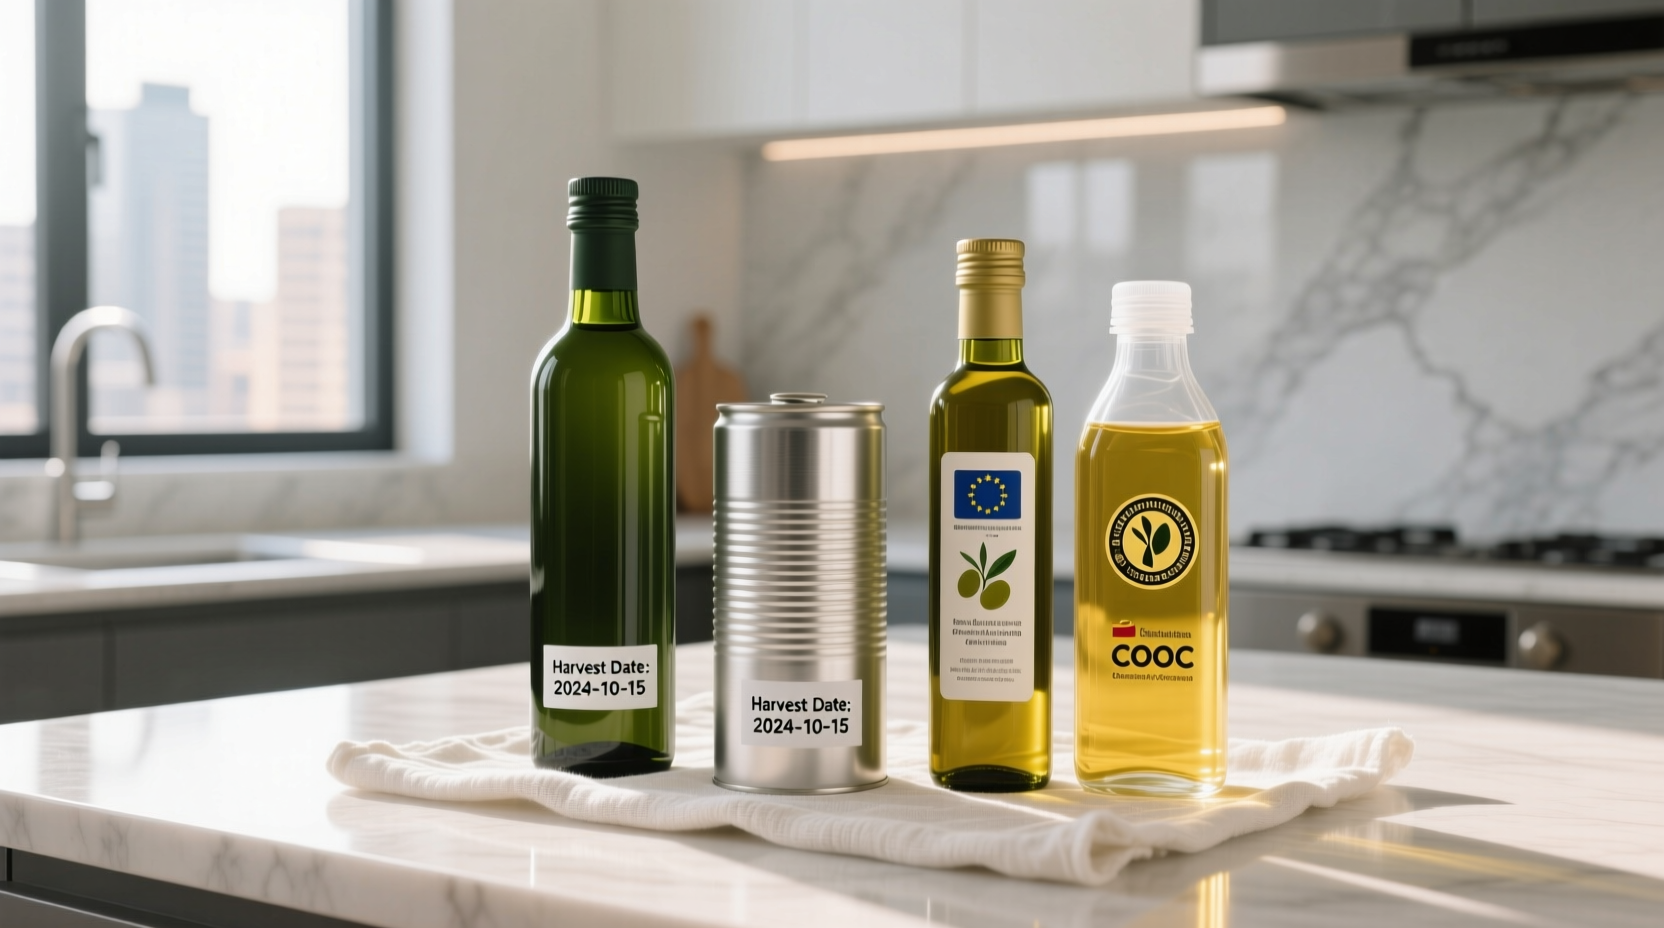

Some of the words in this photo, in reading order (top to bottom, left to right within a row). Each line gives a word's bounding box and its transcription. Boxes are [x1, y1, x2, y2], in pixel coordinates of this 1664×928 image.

[1111, 644, 1194, 669] COOC
[553, 660, 606, 674] Harvest
[611, 660, 650, 674] Date:
[554, 680, 646, 696] 2024-10-15
[752, 696, 808, 712] Harvest
[813, 697, 851, 712] Date:
[753, 717, 849, 734] 2024-10-15
